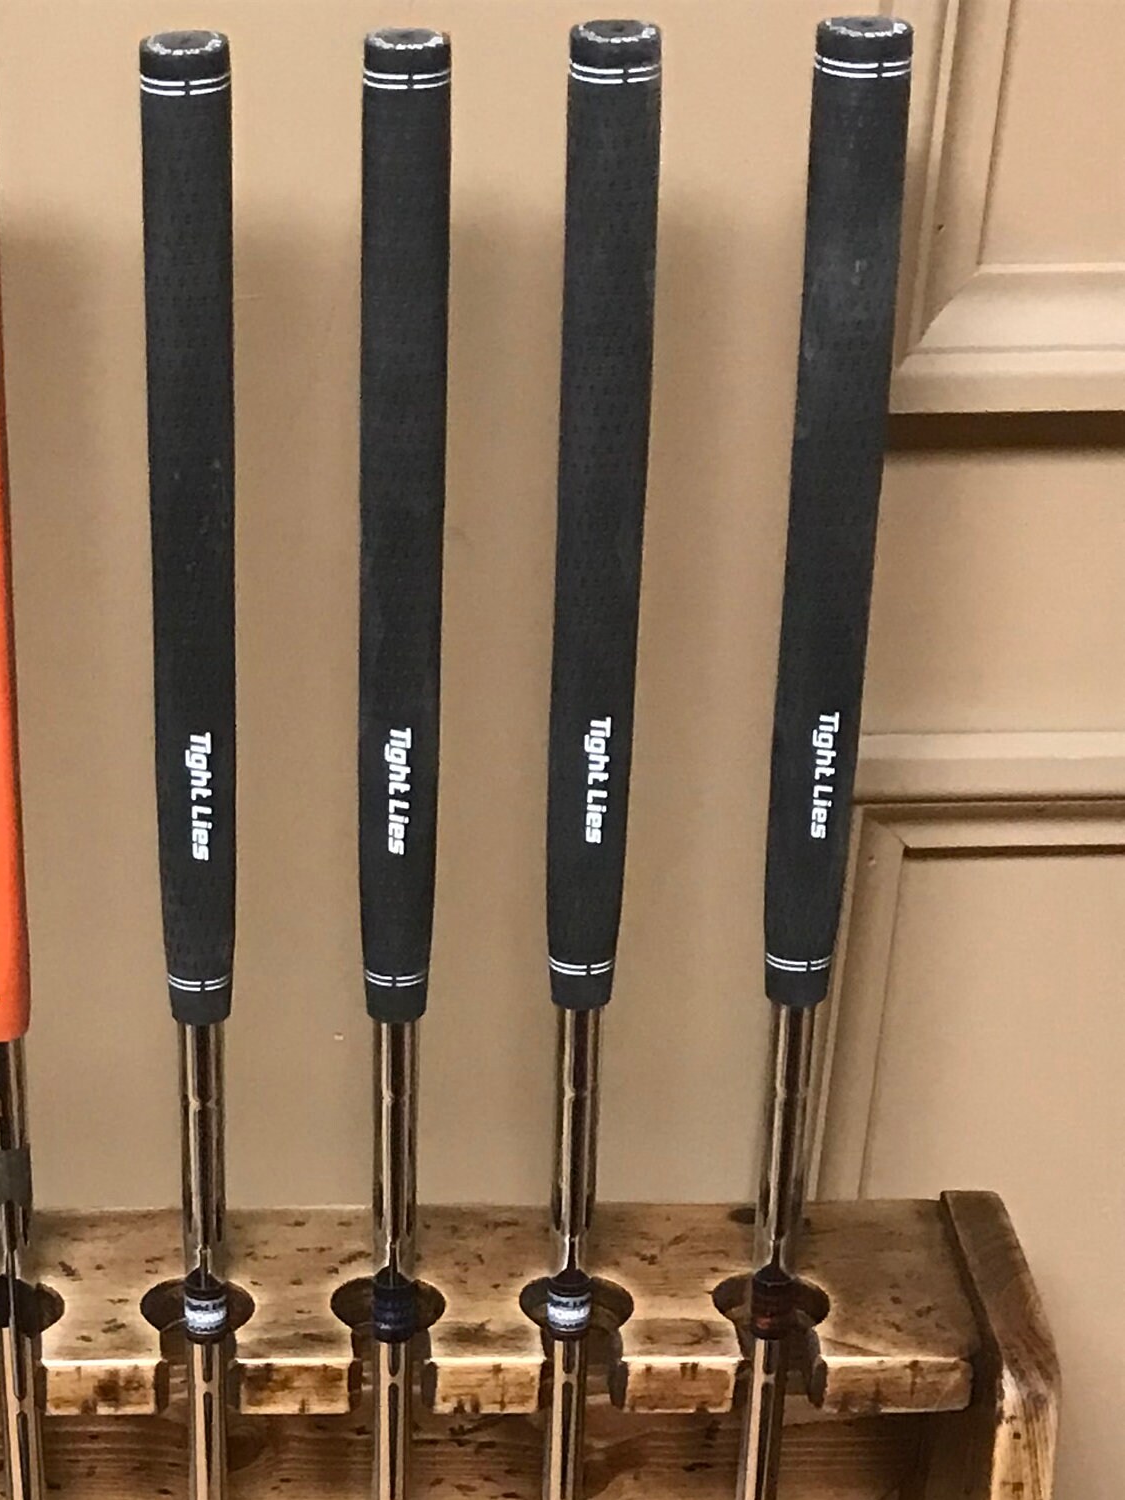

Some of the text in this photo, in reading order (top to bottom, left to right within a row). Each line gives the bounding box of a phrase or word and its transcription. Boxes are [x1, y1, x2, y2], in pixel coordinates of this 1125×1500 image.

[185, 732, 212, 861] Tight Lies
[384, 728, 411, 855] Tight Lies
[584, 717, 611, 843] Tight Lies
[811, 712, 839, 838] Tight Lies
